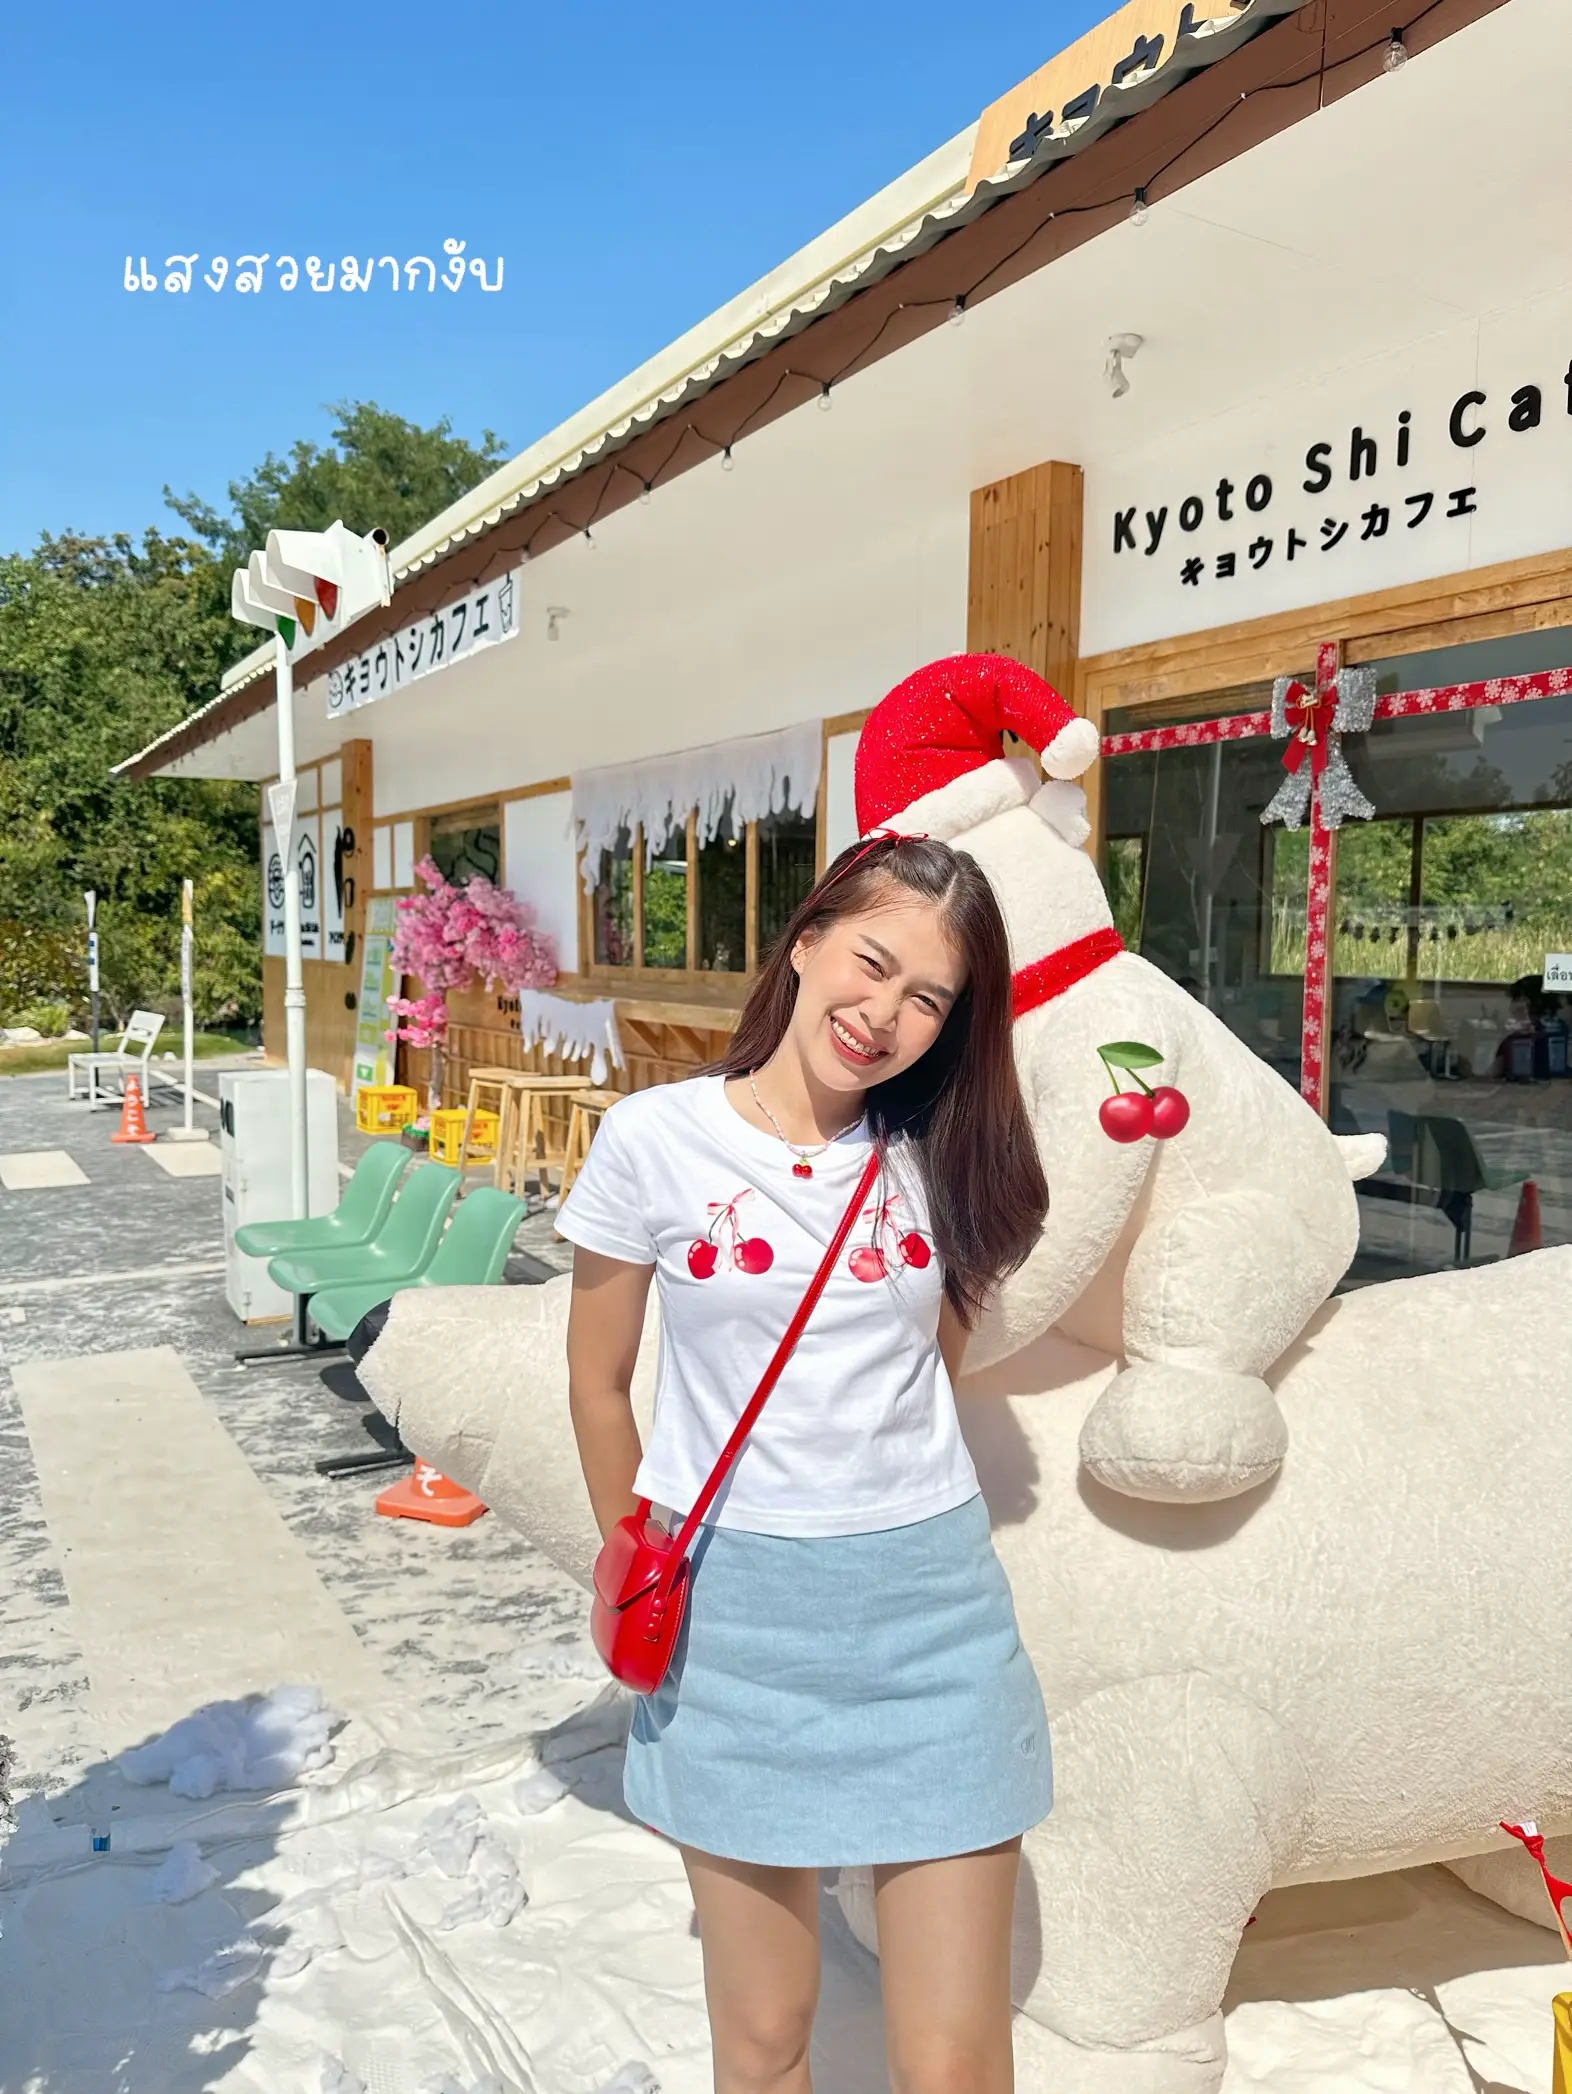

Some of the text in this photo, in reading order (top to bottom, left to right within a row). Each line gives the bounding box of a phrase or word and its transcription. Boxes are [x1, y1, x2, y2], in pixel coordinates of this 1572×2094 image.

[1113, 473, 1273, 556] Kyoto
[1303, 410, 1412, 493] Shi
[1180, 486, 1477, 586] キョウトシカフェ
[344, 594, 490, 702] キョウトシカフェ
